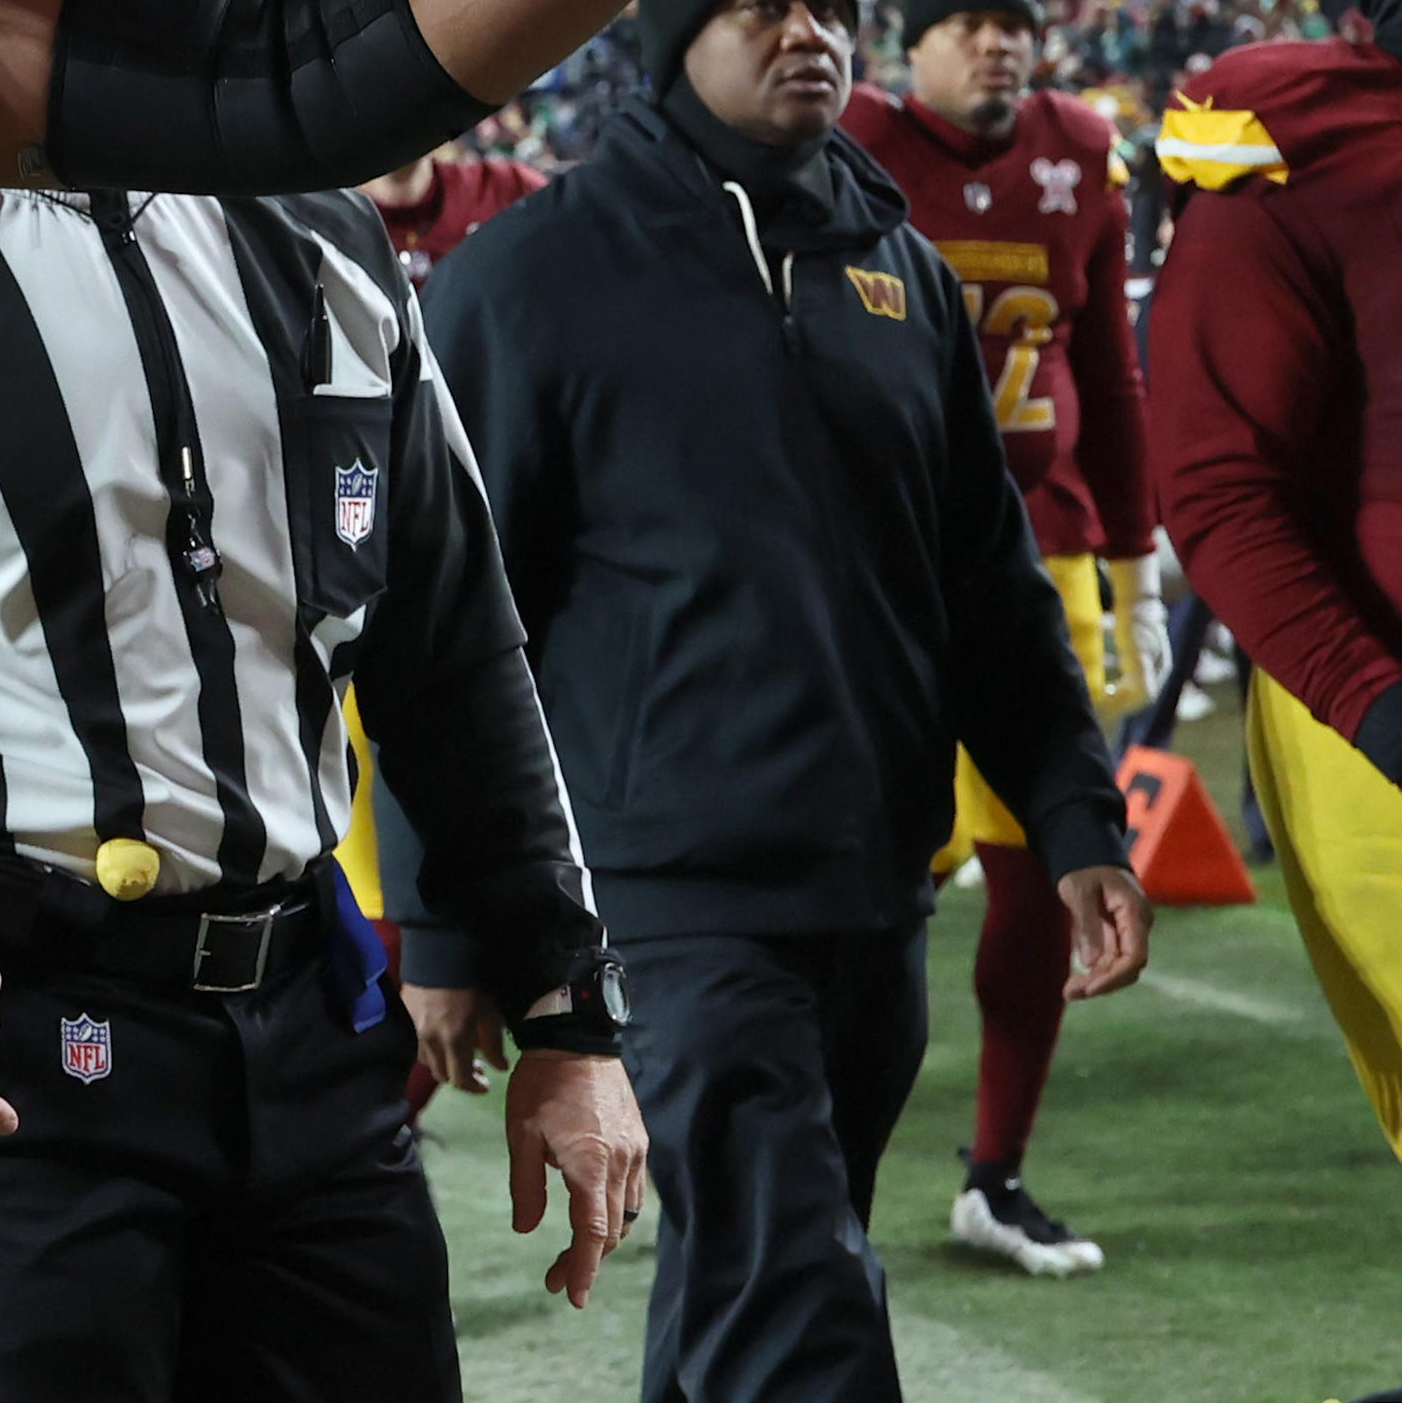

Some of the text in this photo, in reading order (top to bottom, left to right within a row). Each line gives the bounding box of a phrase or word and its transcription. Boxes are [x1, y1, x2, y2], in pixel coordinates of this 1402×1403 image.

[960, 284, 1060, 433] 2
[340, 500, 370, 537] NFL
[68, 1043, 105, 1073] NFL
